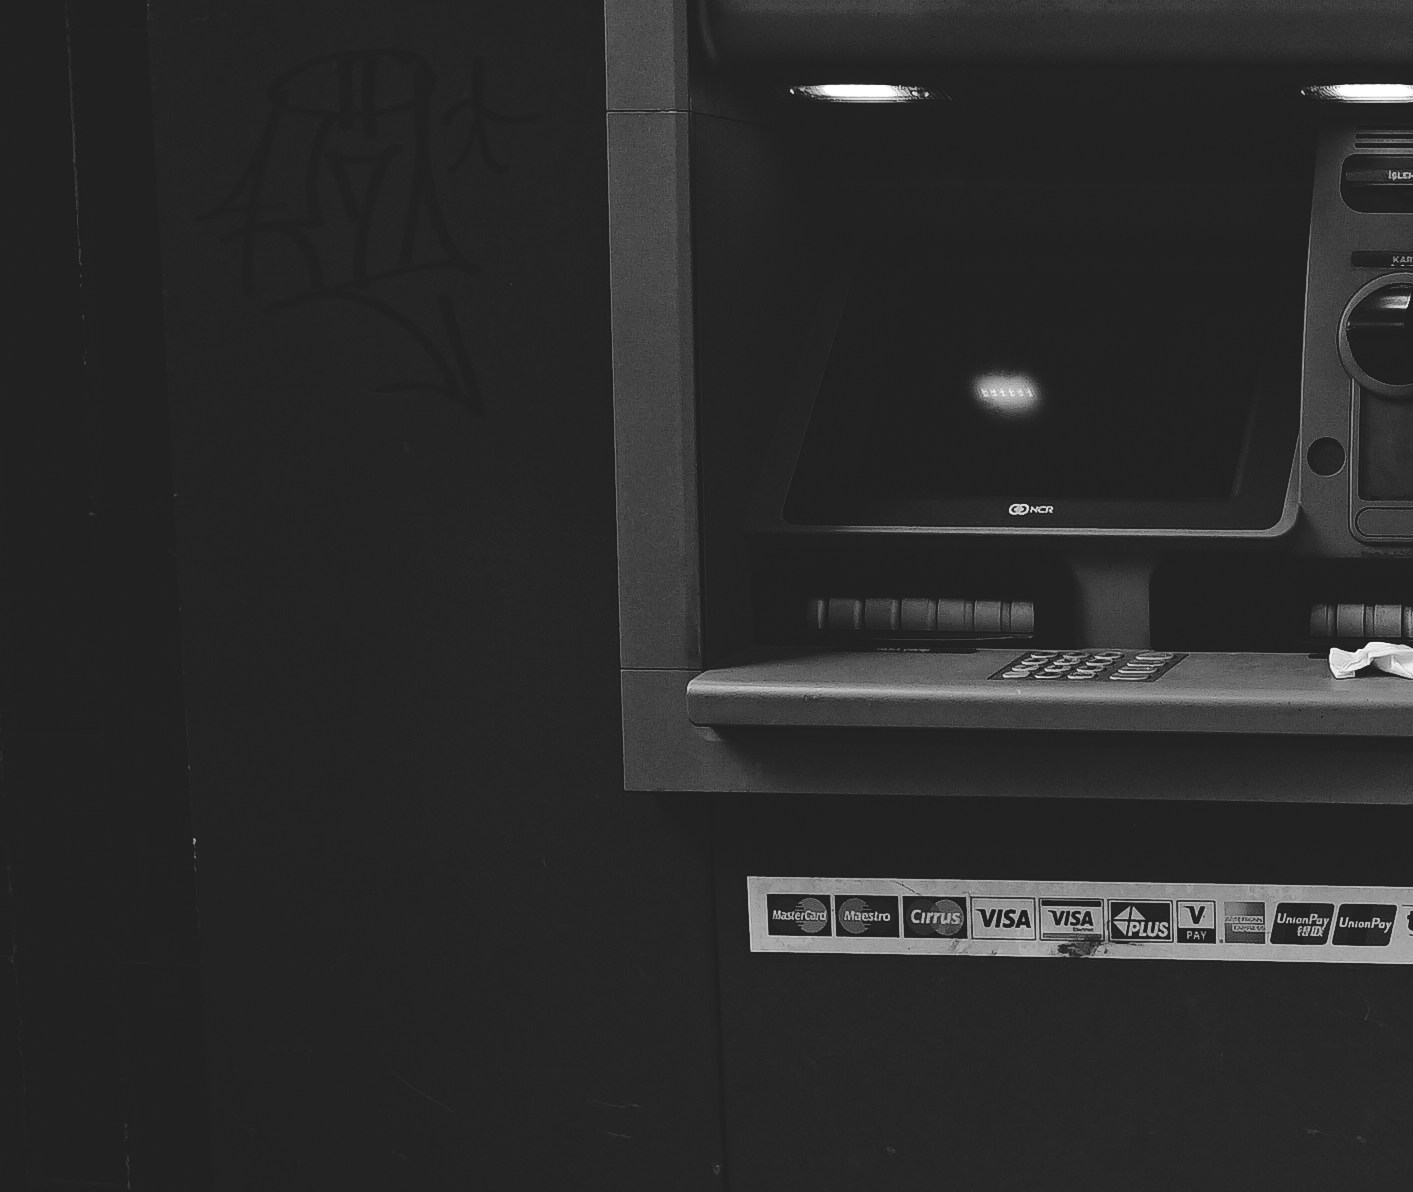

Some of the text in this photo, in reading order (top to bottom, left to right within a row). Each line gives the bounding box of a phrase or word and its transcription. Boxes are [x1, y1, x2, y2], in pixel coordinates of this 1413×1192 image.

[773, 909, 827, 922] MasterCard
[844, 910, 891, 923] Maestro
[911, 909, 960, 924] Cirrus
[976, 908, 1031, 928] VISA
[1048, 910, 1094, 926] VISA
[1182, 905, 1206, 926] V
[1277, 913, 1330, 931] UnionPay
[1128, 921, 1169, 938] PLUS
[1339, 918, 1393, 933] UnionPay
[1187, 930, 1207, 940] PAY
